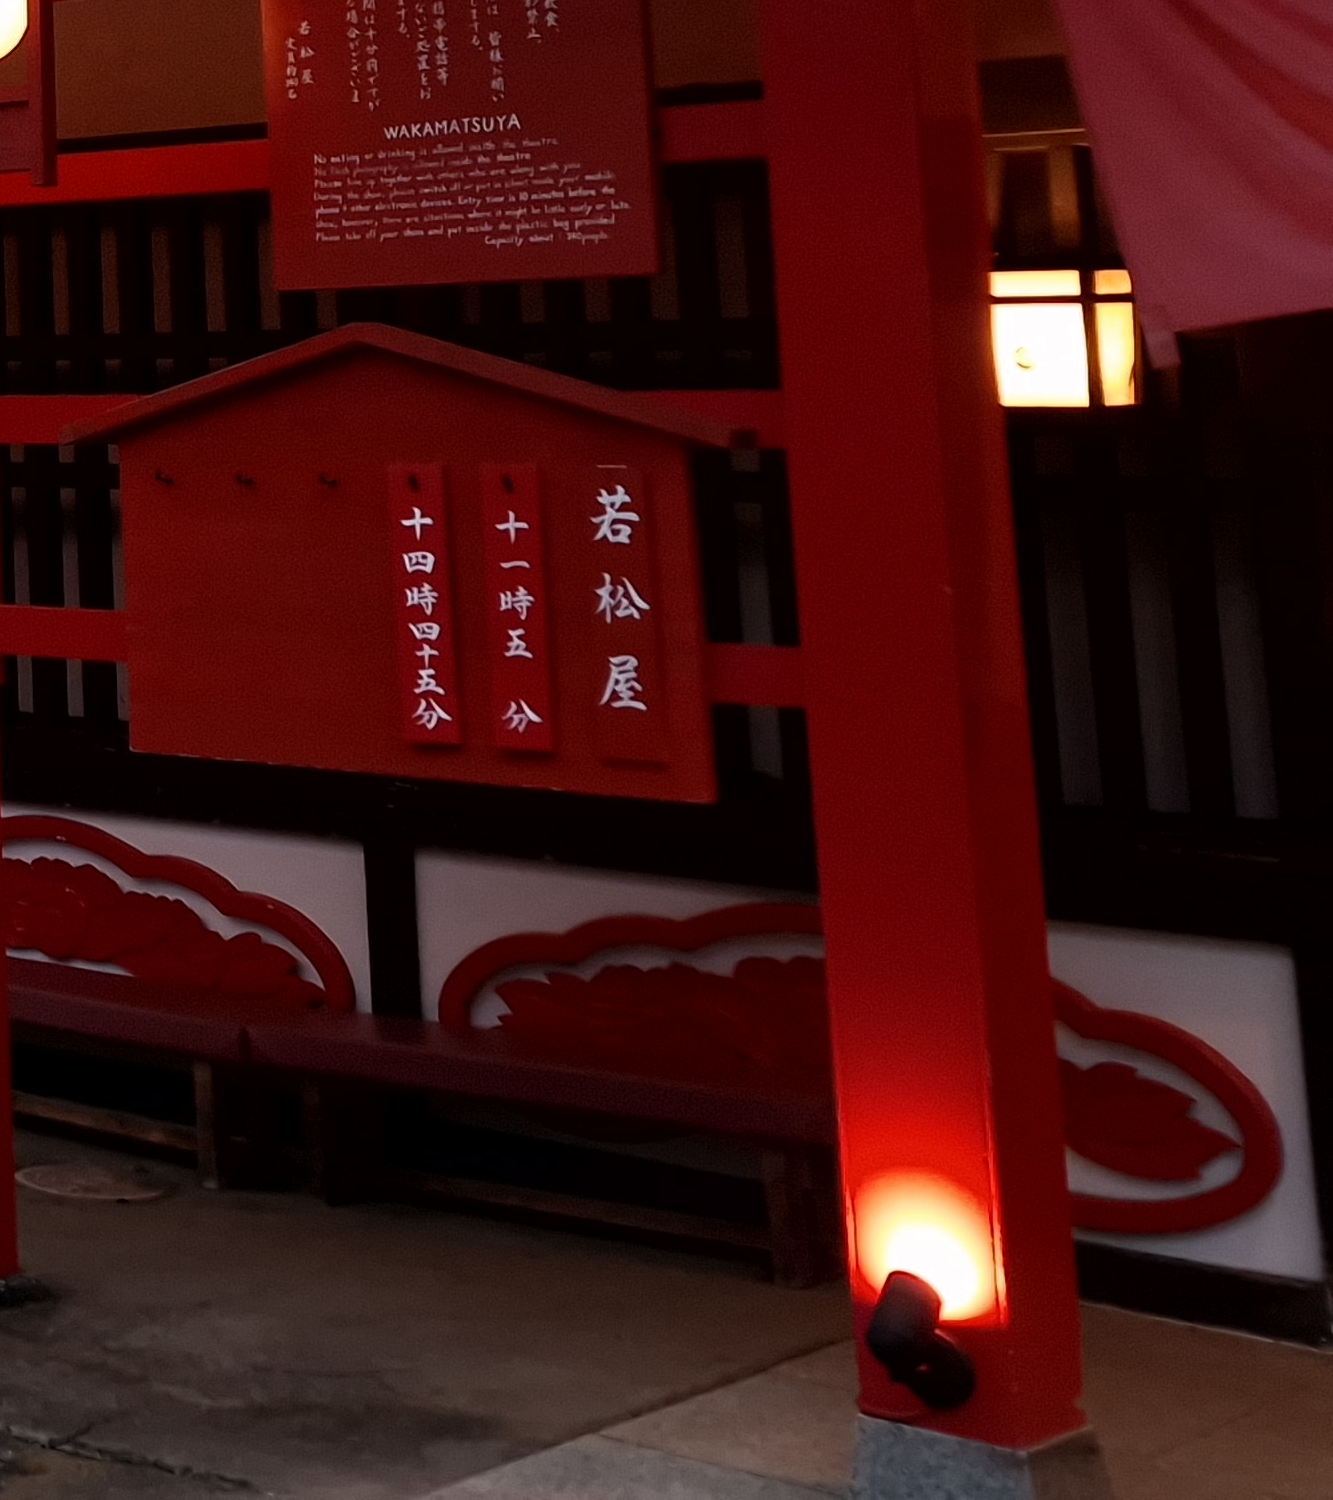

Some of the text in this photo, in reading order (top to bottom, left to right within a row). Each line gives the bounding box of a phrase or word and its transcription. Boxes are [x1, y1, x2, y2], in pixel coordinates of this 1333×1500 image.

[314, 154, 326, 164] No
[384, 113, 521, 139] WAKAMATSUYA
[401, 506, 453, 730] 十四時四十五分
[495, 510, 543, 733] 十一時五分
[589, 484, 650, 710] 若松屋
